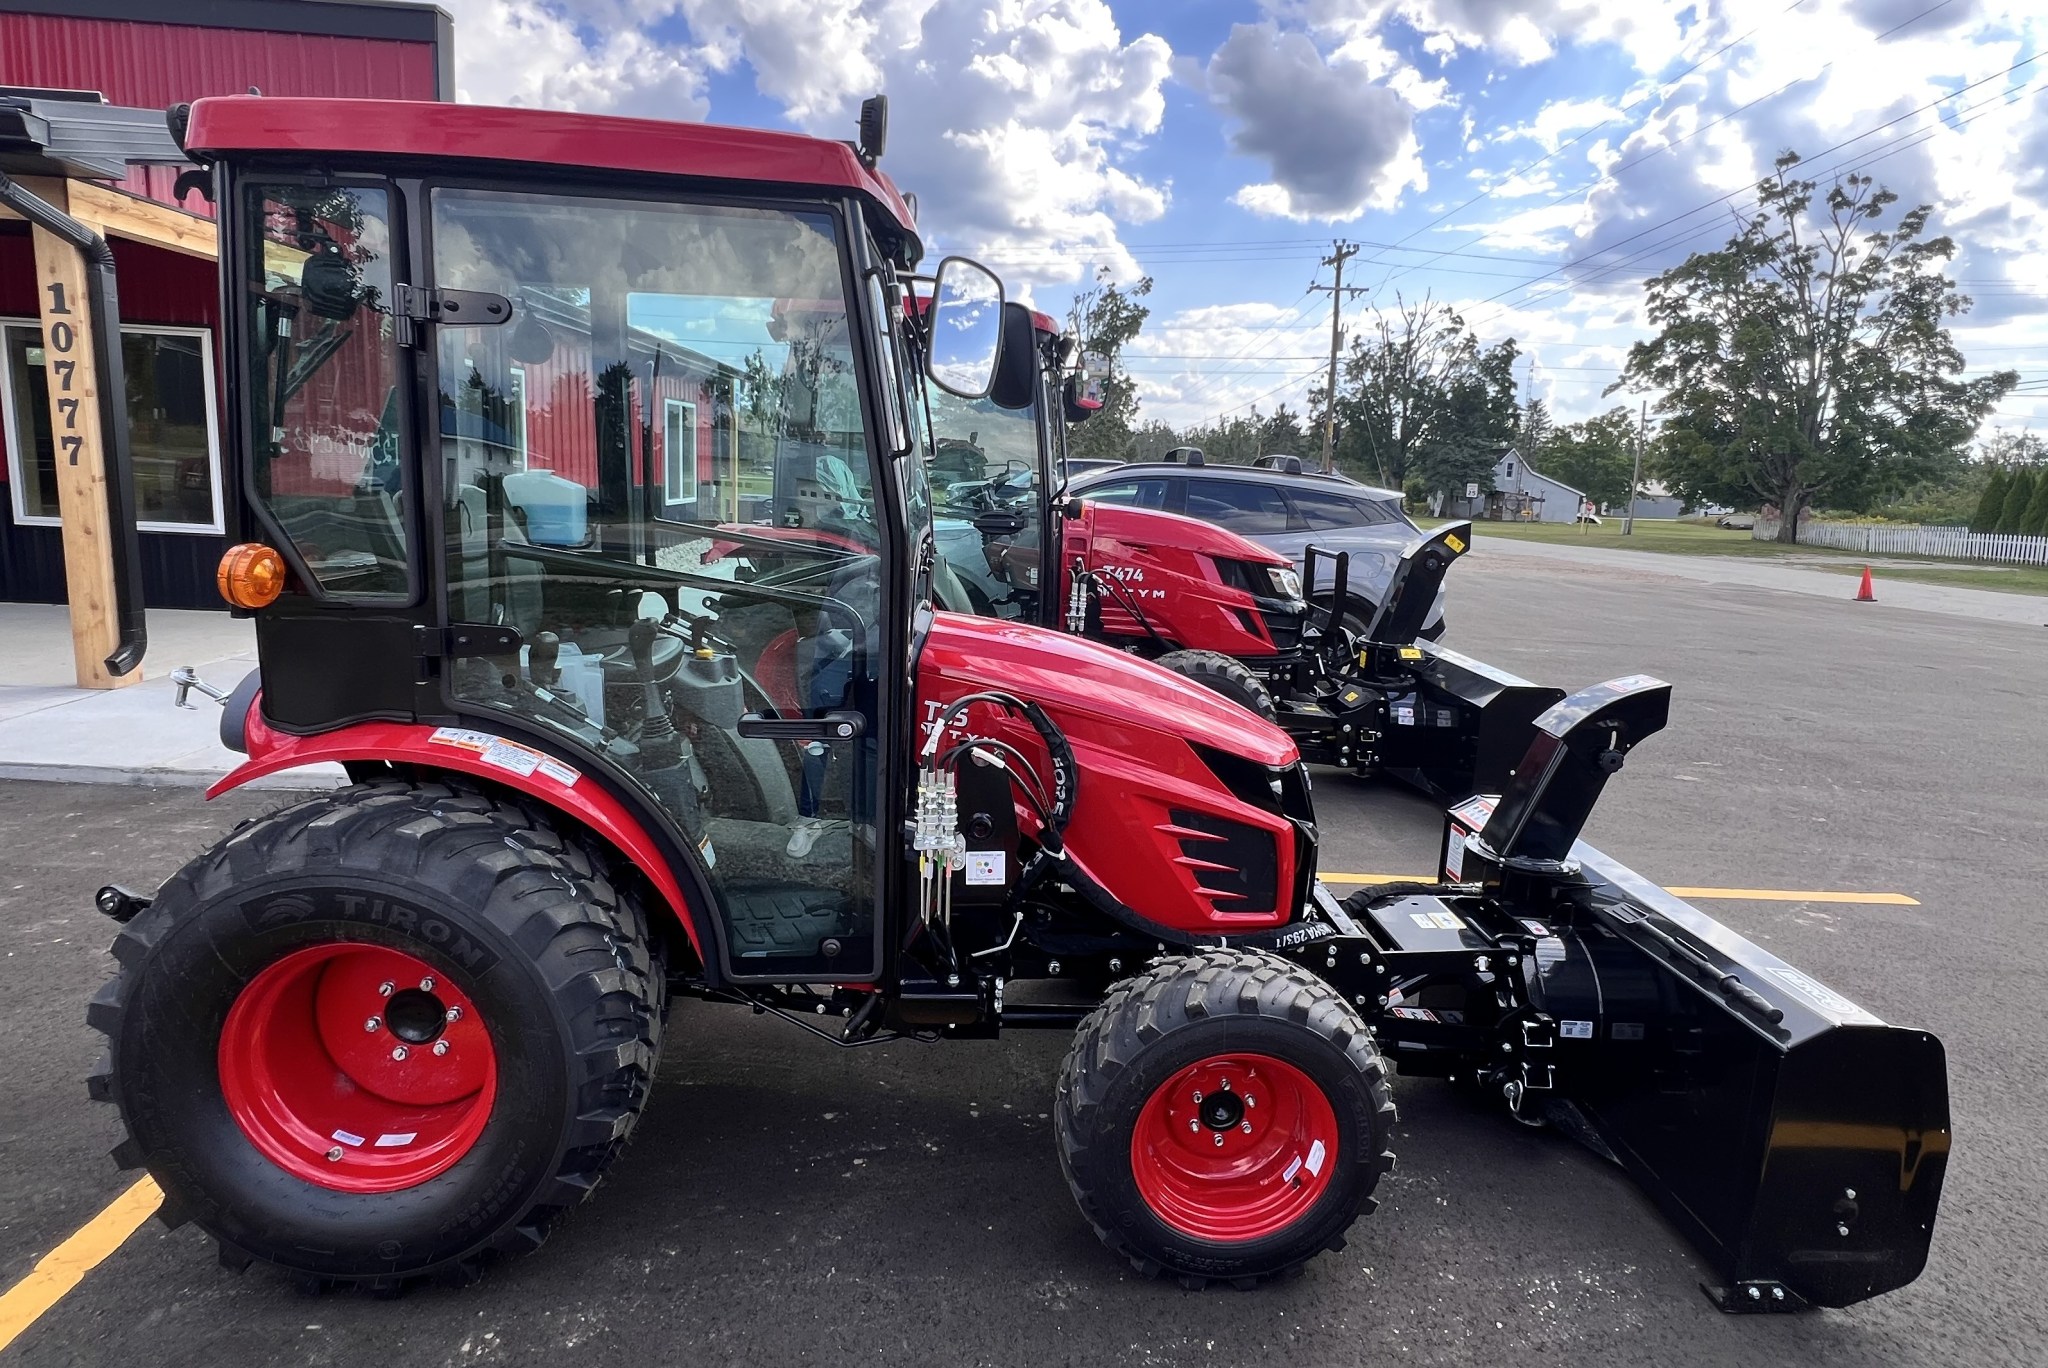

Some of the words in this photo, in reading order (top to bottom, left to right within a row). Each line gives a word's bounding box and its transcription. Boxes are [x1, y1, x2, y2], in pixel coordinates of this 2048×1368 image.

[47, 282, 83, 466] 10777
[1103, 565, 1143, 582] T474
[335, 894, 486, 968] TIRON
